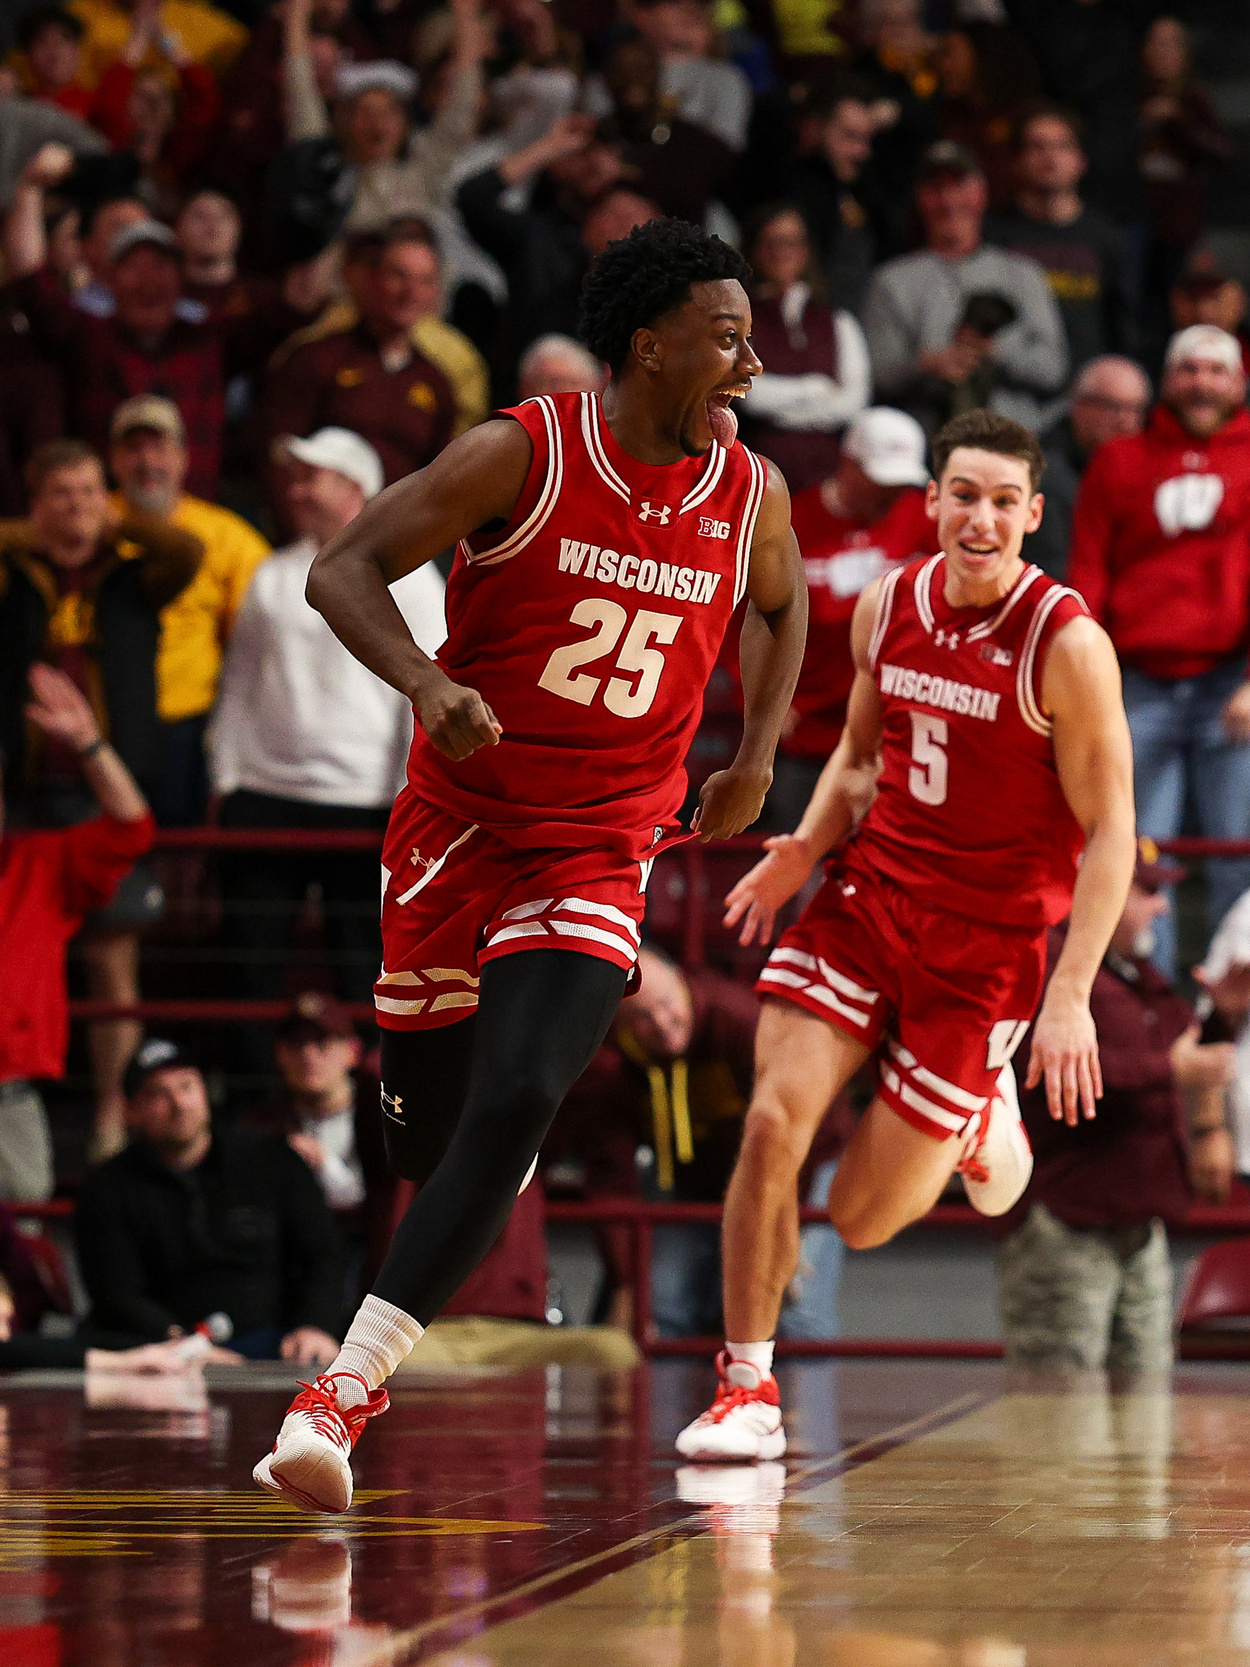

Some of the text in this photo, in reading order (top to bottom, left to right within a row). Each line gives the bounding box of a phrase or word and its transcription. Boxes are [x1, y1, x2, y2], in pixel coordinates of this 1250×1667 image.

[698, 516, 731, 540] BIG
[558, 537, 722, 604] WISCONSIN
[537, 598, 684, 718] 25
[880, 663, 1001, 722] WISCONSIN
[908, 710, 948, 806] 5
